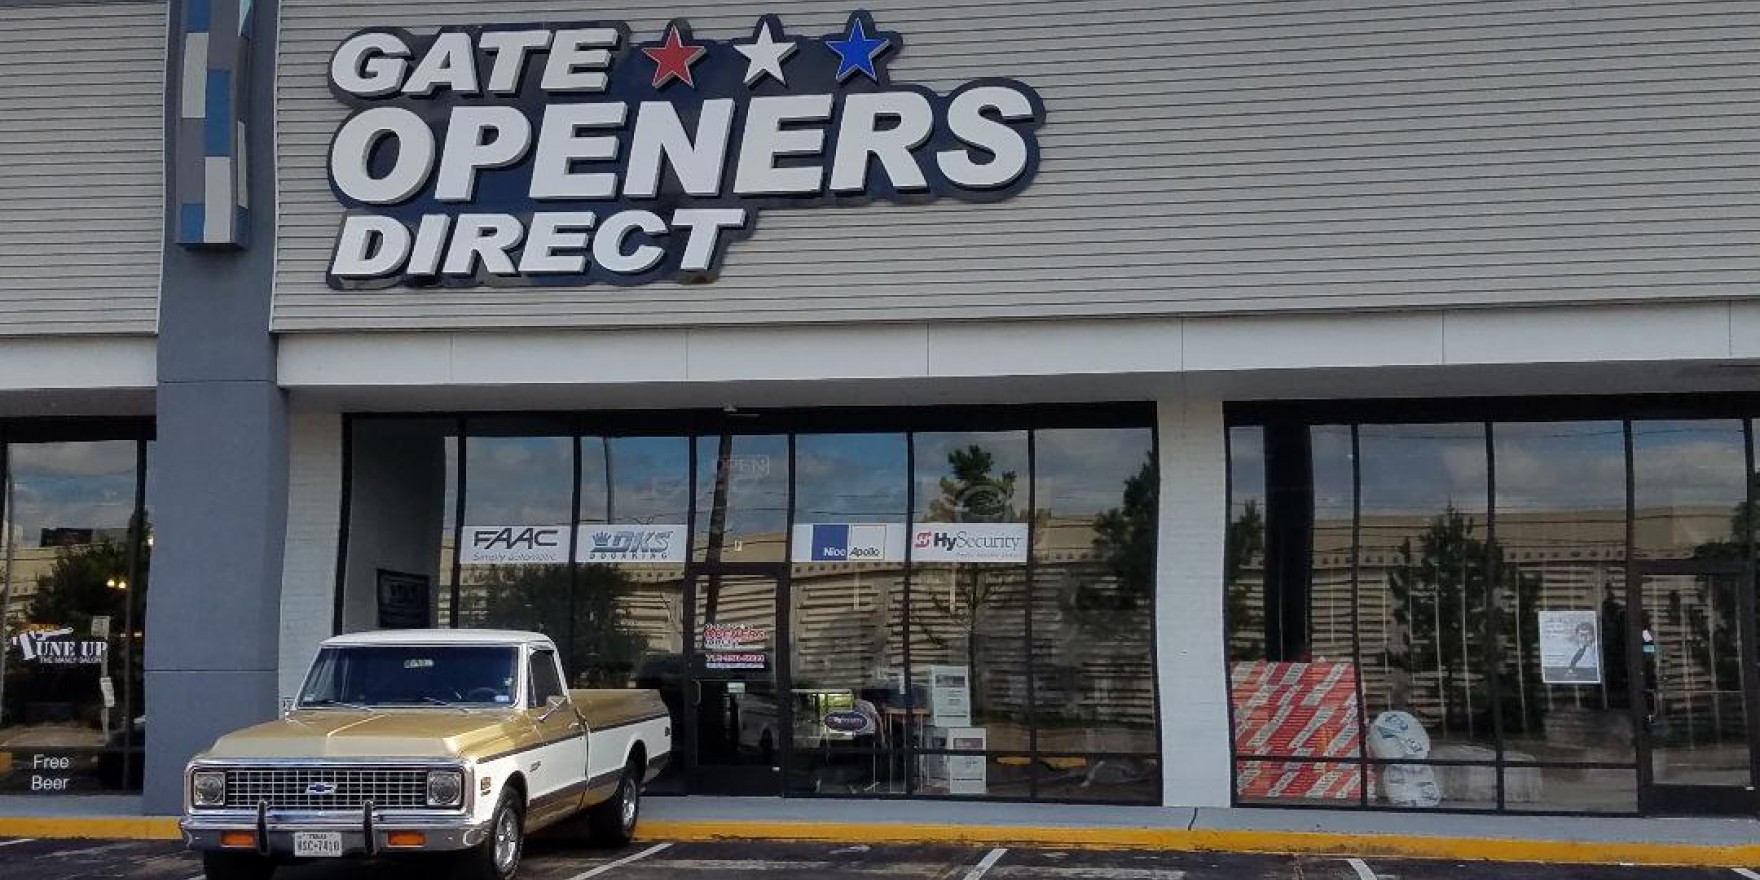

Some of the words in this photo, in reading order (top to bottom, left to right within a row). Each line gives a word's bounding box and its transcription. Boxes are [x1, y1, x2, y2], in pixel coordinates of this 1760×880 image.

[331, 28, 618, 96] GATE
[330, 86, 1035, 203] OPENERS
[331, 207, 747, 276] DIRECT
[473, 527, 558, 550] FAAC
[591, 530, 674, 553] DKS
[933, 530, 1023, 551] HySecurity
[589, 552, 668, 560] DOORKING
[81, 641, 108, 656] UP
[33, 753, 70, 770] Free
[31, 775, 71, 791] Beer
